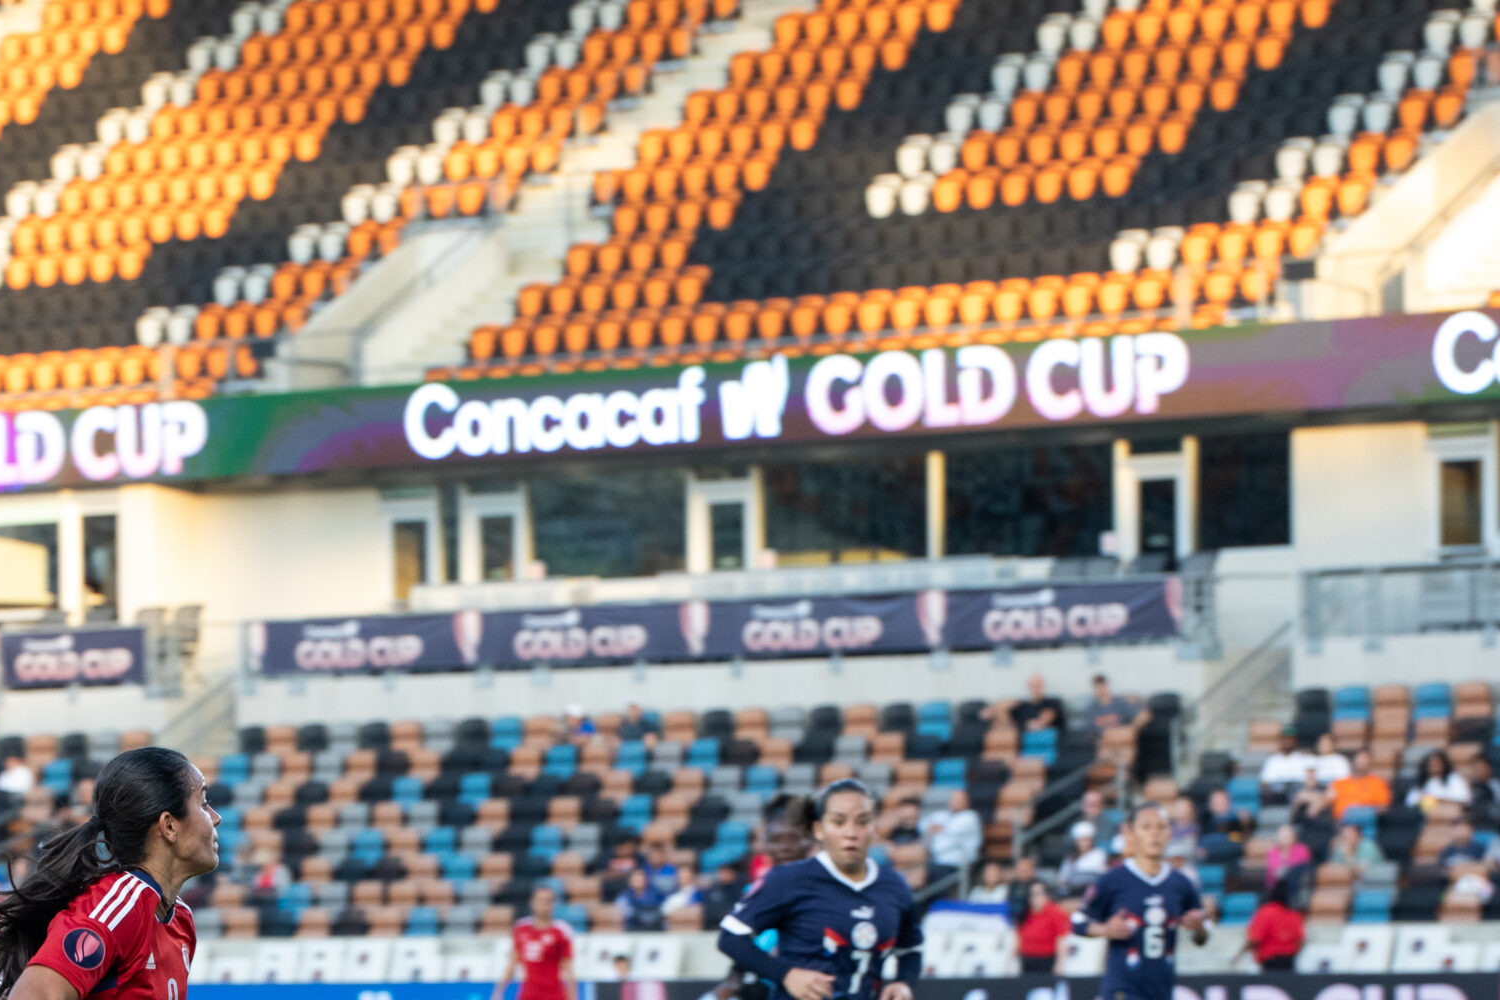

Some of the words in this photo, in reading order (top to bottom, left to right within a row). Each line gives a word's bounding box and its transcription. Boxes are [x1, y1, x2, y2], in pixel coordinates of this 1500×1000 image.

[405, 366, 706, 459] Concacaf
[806, 344, 1017, 435] GOLD
[1025, 332, 1190, 420] CUP
[71, 400, 208, 481] CUP
[849, 951, 872, 994] 7
[1143, 926, 1165, 958] 6
